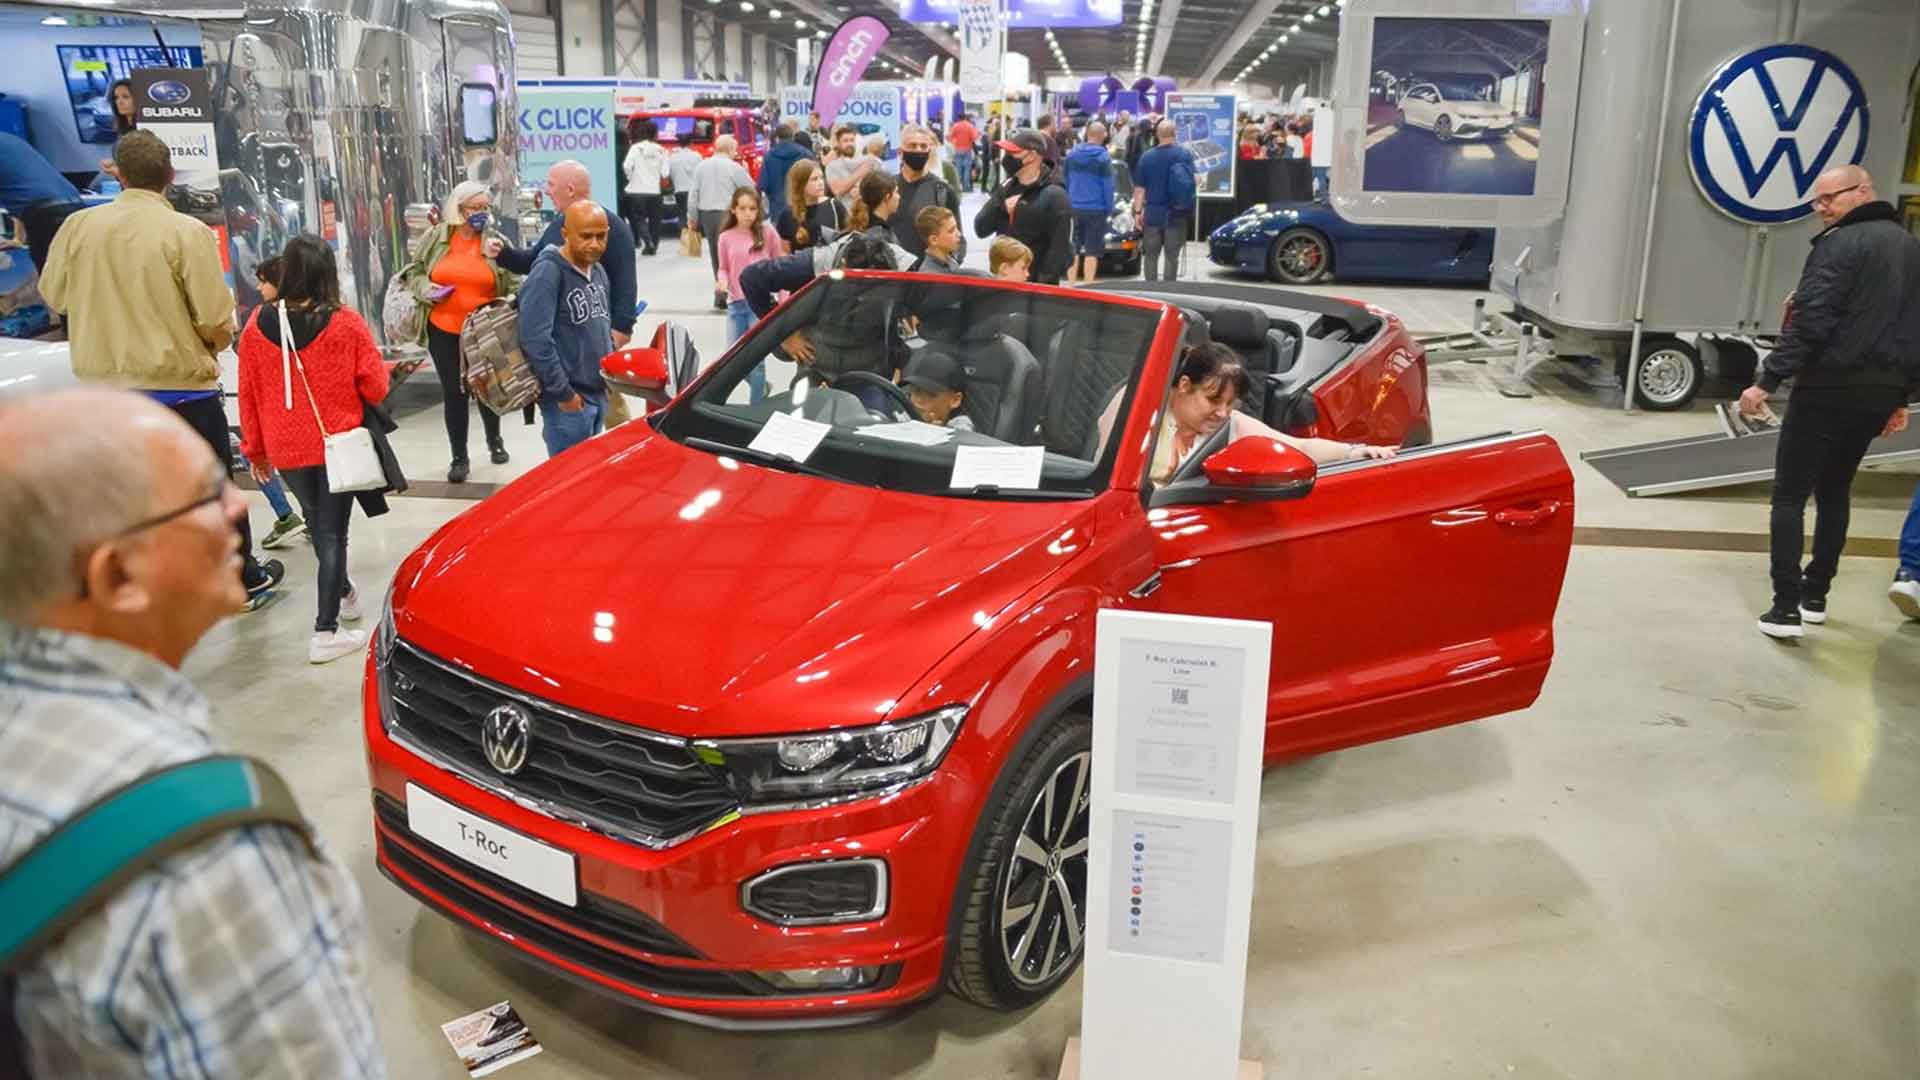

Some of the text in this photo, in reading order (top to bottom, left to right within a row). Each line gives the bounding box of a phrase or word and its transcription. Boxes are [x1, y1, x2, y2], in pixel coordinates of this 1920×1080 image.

[829, 29, 873, 87] cinch
[142, 107, 202, 118] SUBARU
[786, 101, 893, 116] DIN DONG
[537, 107, 606, 131] CLICK
[538, 132, 609, 151] VROOM
[171, 146, 204, 157] TBACK
[457, 821, 510, 860] T-Roc
